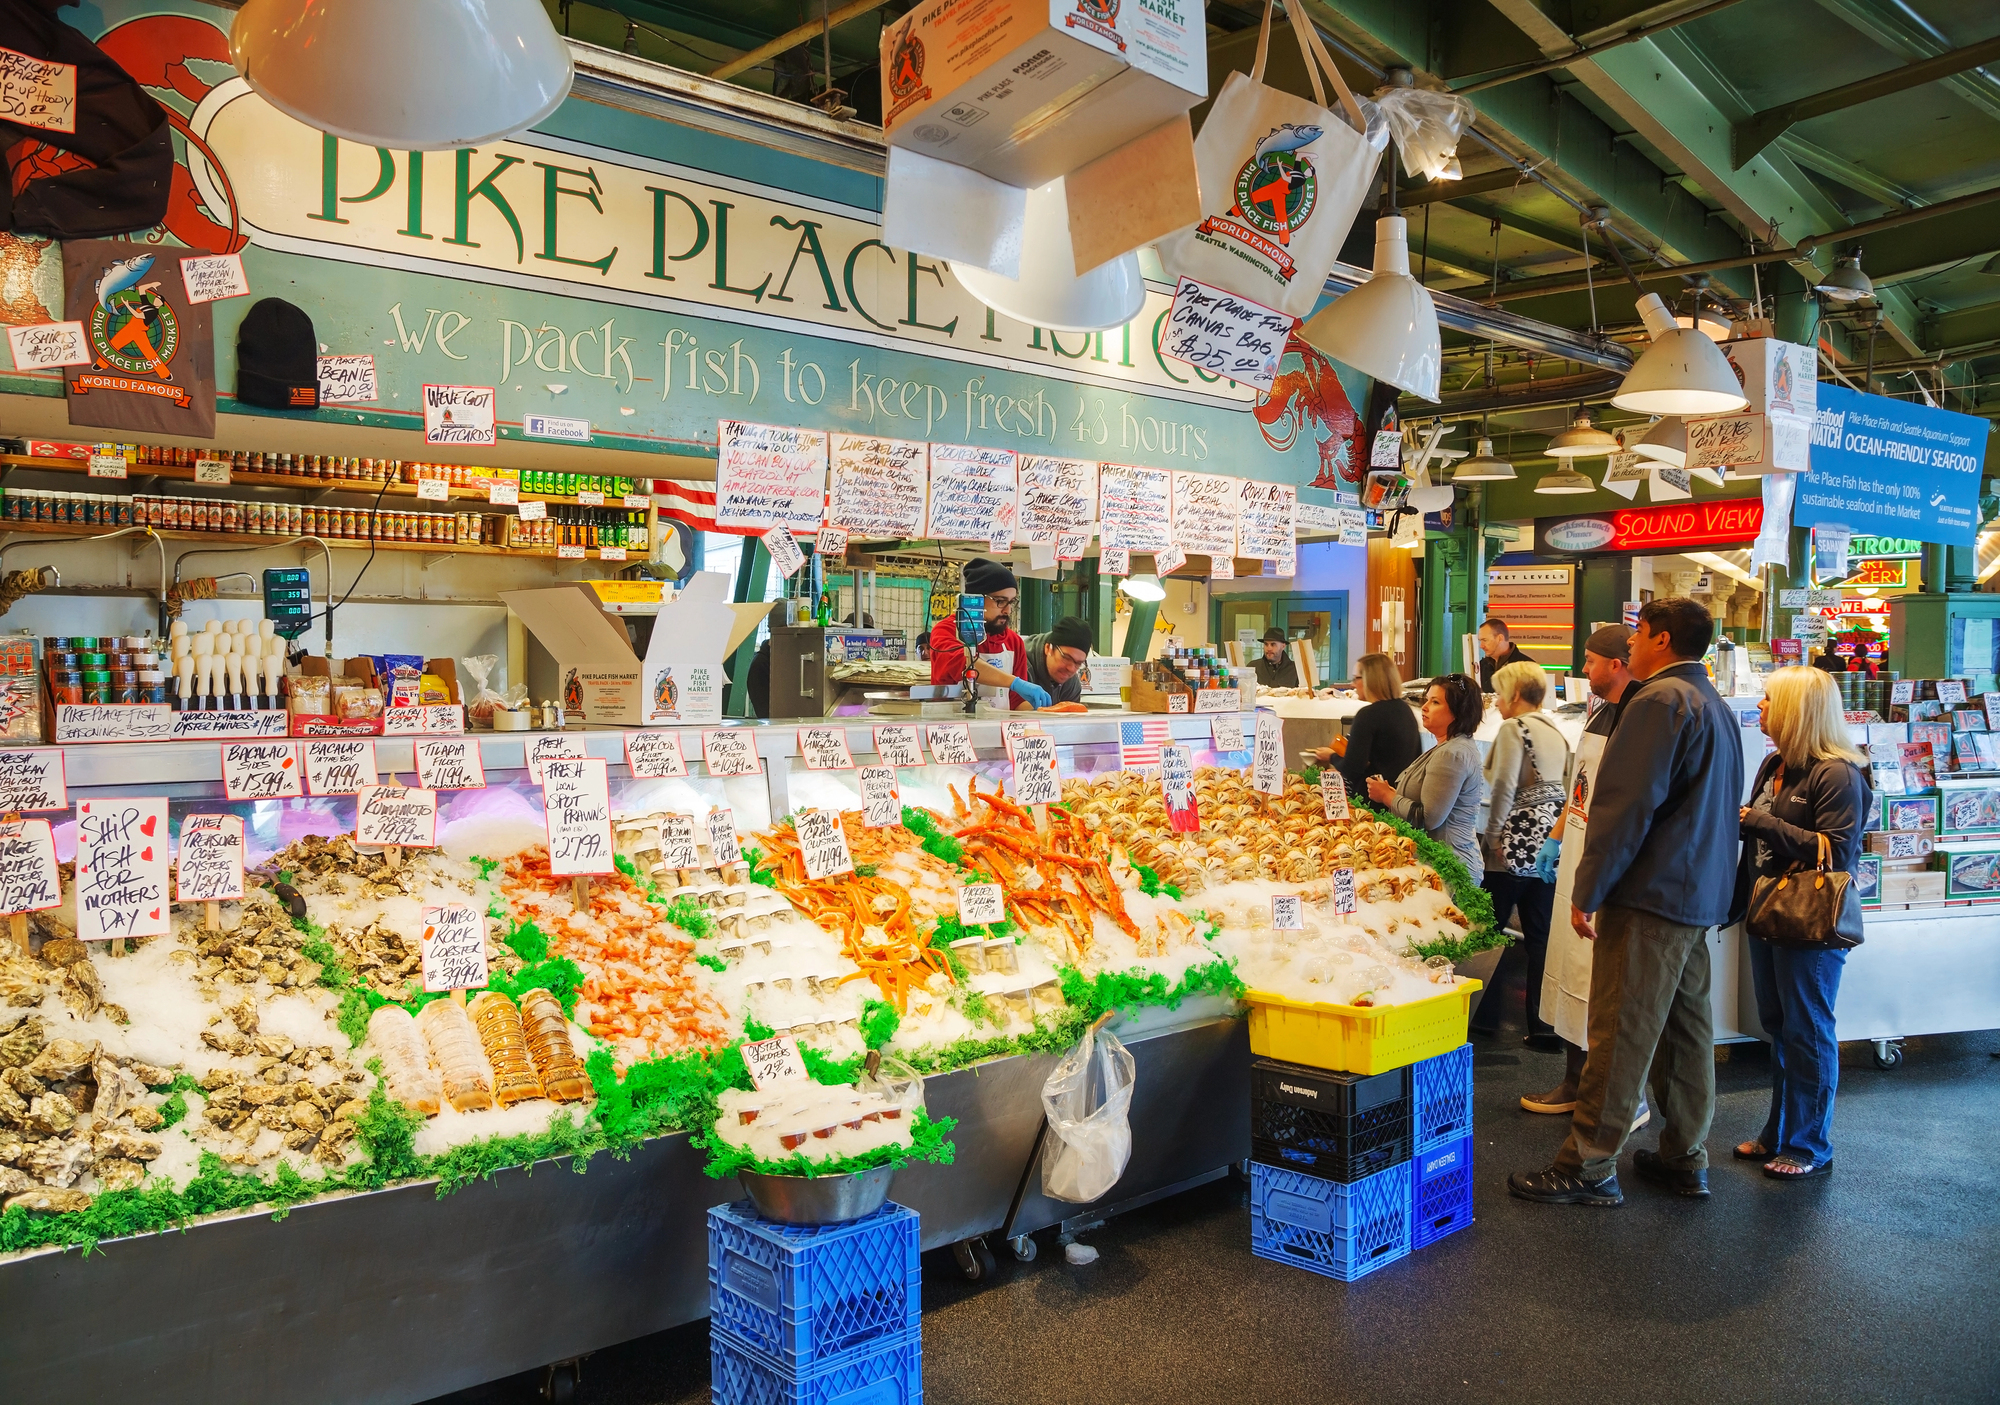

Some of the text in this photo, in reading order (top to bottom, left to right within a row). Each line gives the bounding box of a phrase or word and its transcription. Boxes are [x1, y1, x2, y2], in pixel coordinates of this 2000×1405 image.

[922, 6, 942, 27] PIKE
[1140, 0, 1185, 26] MARKET
[1071, 15, 1122, 44] WORLD FAMOUS
[946, 15, 1014, 64] www.pikeplacefish.com
[1012, 49, 1051, 74] PIONEER
[977, 77, 1015, 102] PIKE PLACE
[995, 88, 1014, 100] MINI
[1238, 163, 1315, 231] PIKE PLACE FISH MARKET
[307, 131, 957, 332] PIKE PLACE
[1210, 218, 1291, 268] WORLD FAMOUS
[1195, 233, 1287, 287] SEATTLE, WASHINGTON, USA
[1172, 306, 1272, 356] CANVAS BAG
[92, 310, 176, 371] PIKE PLACE FISH MARKET
[1802, 350, 1813, 358] PIKE
[319, 366, 374, 383] BEANIE
[1798, 372, 1816, 381] MARKET
[82, 376, 182, 398] WORLD FAMOUS
[498, 318, 637, 394] pack
[659, 327, 760, 402] fish
[777, 346, 827, 406] to
[847, 356, 948, 438] keep
[962, 376, 1058, 446] fresh
[1069, 397, 1109, 446] 48
[1118, 401, 1208, 462] hours
[463, 391, 489, 408] GOT
[547, 426, 583, 438] Facebook
[726, 422, 758, 437] HAVING
[769, 430, 800, 444] TOUGH
[1691, 422, 1718, 439] OUR
[1810, 423, 1843, 449] WATCH
[1816, 408, 1970, 447] eafood Pike Place Fish and Seattle Aquarium Support
[728, 438, 768, 451] GETTING
[840, 437, 868, 452] LIVE
[1695, 437, 1715, 449] CAN
[1845, 433, 1977, 473] OCEAN-FRIENDLY SEAFOOD
[727, 449, 816, 476] YOU CAN BUY OUR
[1021, 457, 1083, 476] DUNGENESS
[729, 466, 783, 480] SEAFOOD
[1025, 472, 1086, 490] CRAB FEAST
[1804, 471, 1921, 500] Pike Place Fish has the only 100%
[1802, 493, 1921, 520] sustainable seafood in the Market
[1617, 508, 1760, 537] SOUND VIEW
[1566, 530, 1593, 539] Dinner
[63, 706, 92, 722] PIKE
[92, 707, 129, 722] PLACE
[174, 721, 249, 733] OYSTER KNIVES
[227, 744, 288, 761] BACALAO
[309, 742, 364, 756] BACALAO
[628, 742, 657, 752] BLACK
[706, 741, 729, 753] TRUE
[1014, 738, 1047, 750] JUMBO
[1016, 748, 1051, 764] ALASKAN
[236, 761, 272, 770] SIDES
[1022, 762, 1044, 774] KING
[1024, 772, 1050, 782] CRAB
[556, 781, 578, 791] LOCAL
[363, 798, 432, 816] KUMAMOTO
[546, 793, 589, 810] SPOT
[191, 815, 224, 828] LIVE!
[564, 803, 607, 825] PRAWNS
[798, 812, 829, 828] SNOW
[182, 832, 242, 848] TREASURE
[802, 824, 832, 840] CRAB
[805, 835, 840, 850] CLUSTERS
[182, 860, 232, 878] OYSTERS
[85, 885, 160, 912] MOTHERS
[100, 908, 140, 936] DAY
[425, 907, 477, 925] JUMBO
[434, 925, 477, 944] ROCK
[430, 942, 482, 959] LOBSTER
[440, 956, 472, 967] TAILS
[748, 1039, 782, 1056] OYSTER
[1280, 1081, 1318, 1099] Anderson Dairy
